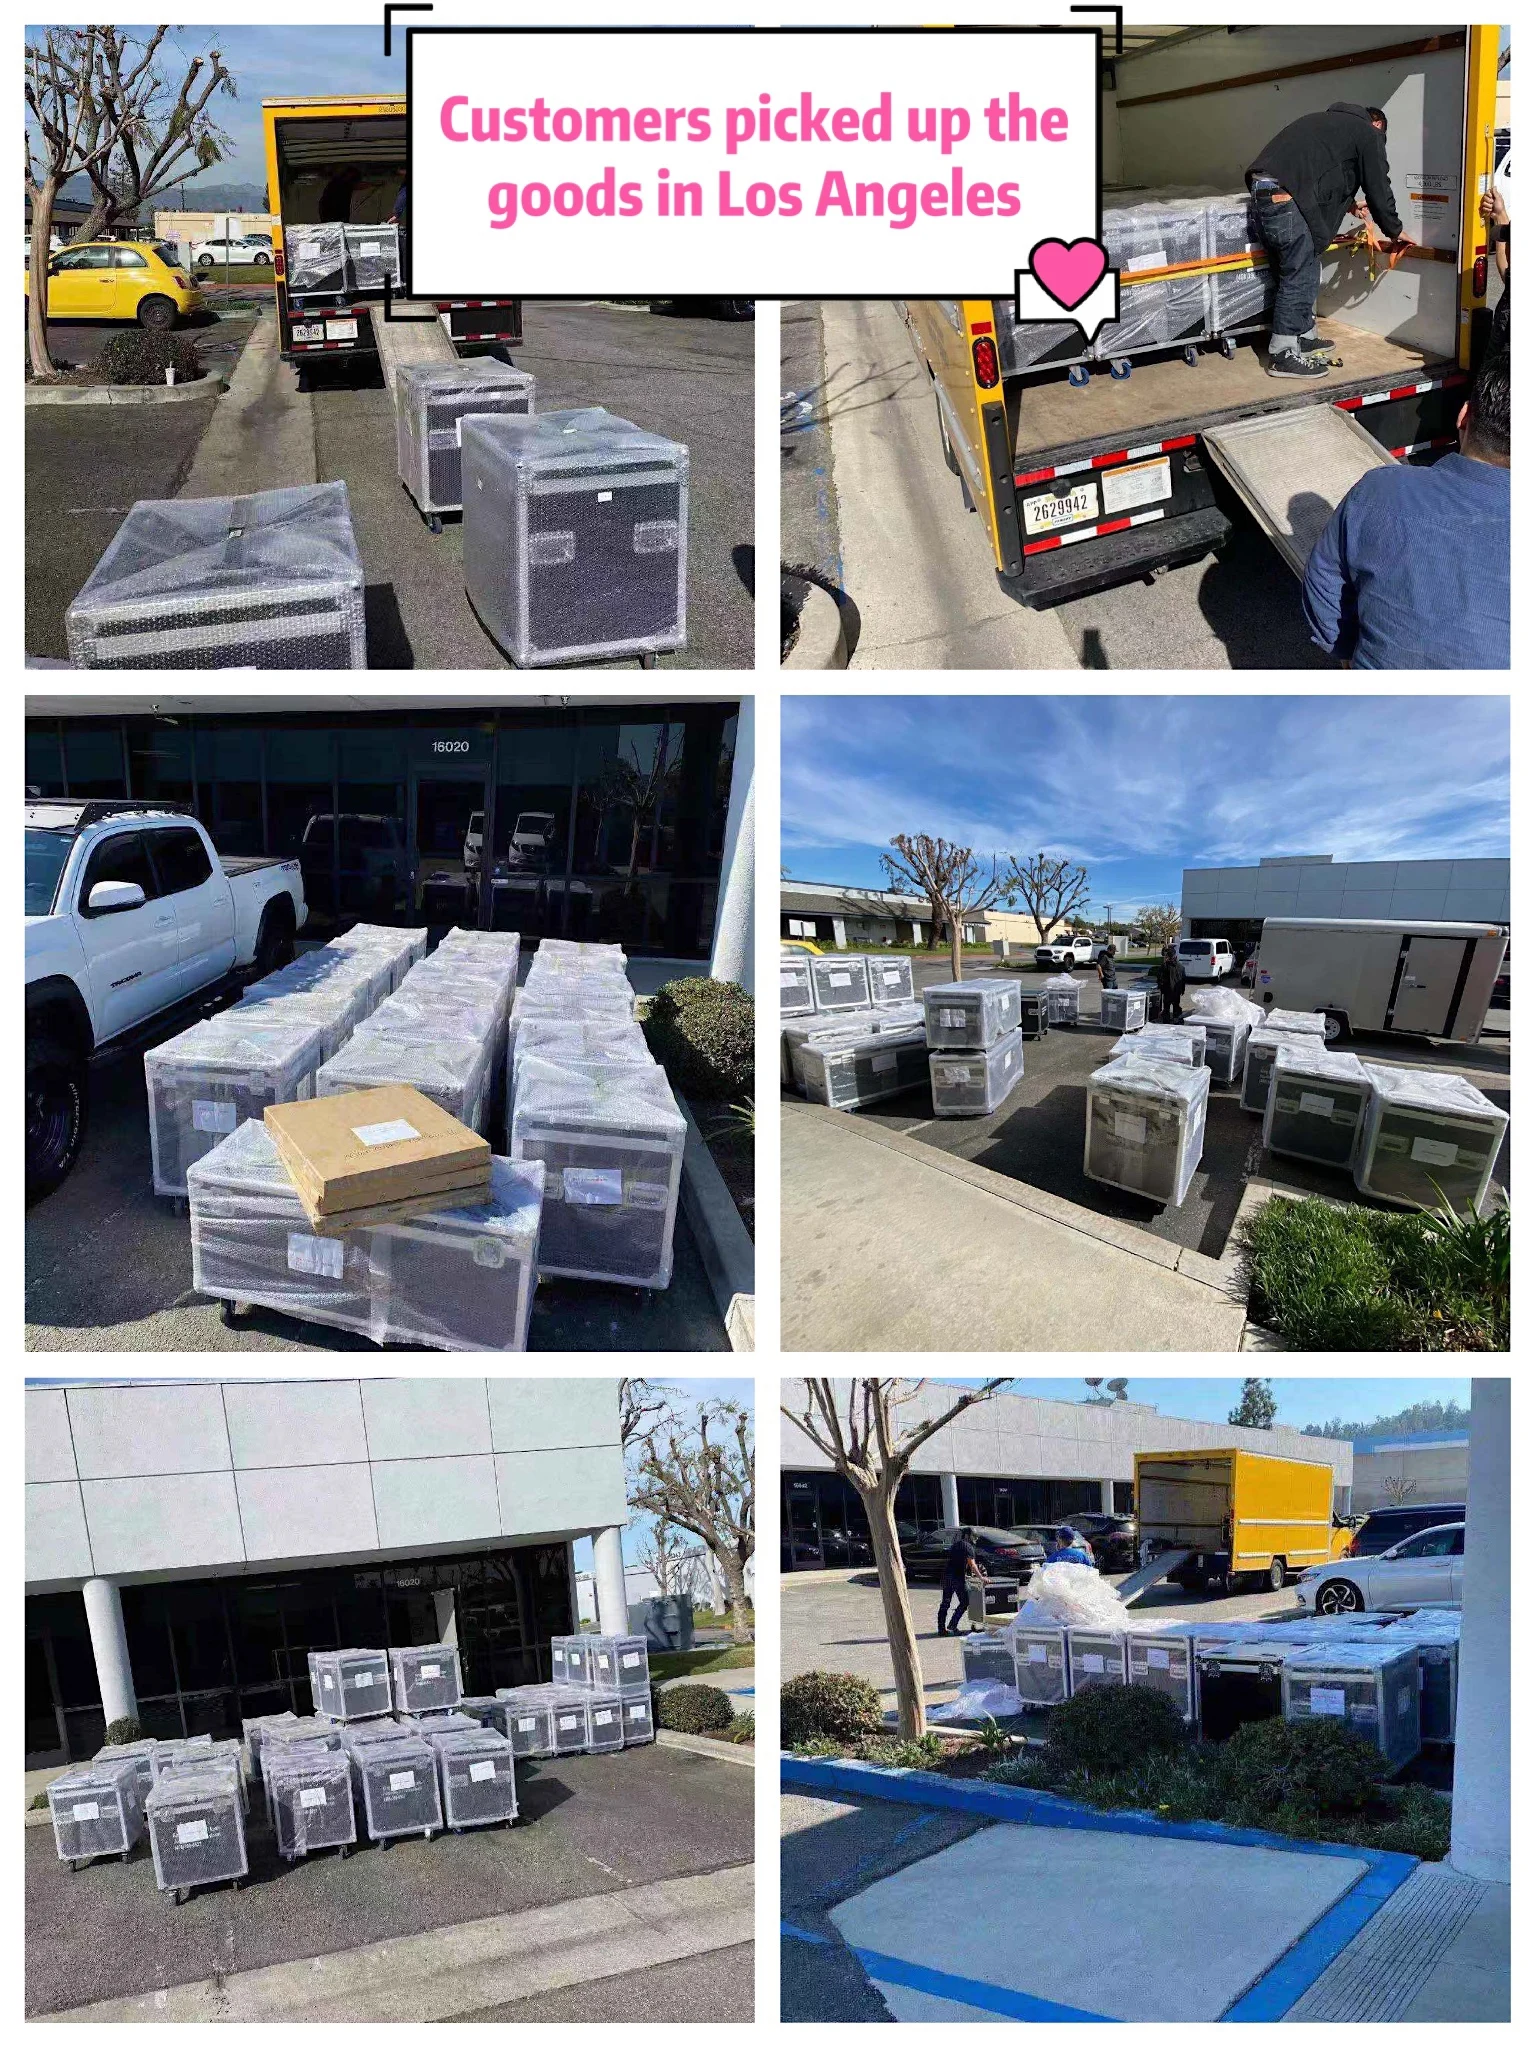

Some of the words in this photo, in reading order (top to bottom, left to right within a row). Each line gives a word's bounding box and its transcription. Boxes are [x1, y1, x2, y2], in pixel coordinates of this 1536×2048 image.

[1033, 494, 1088, 522] 2629942
[431, 740, 470, 752] 16020
[396, 1578, 420, 1588] 16020
